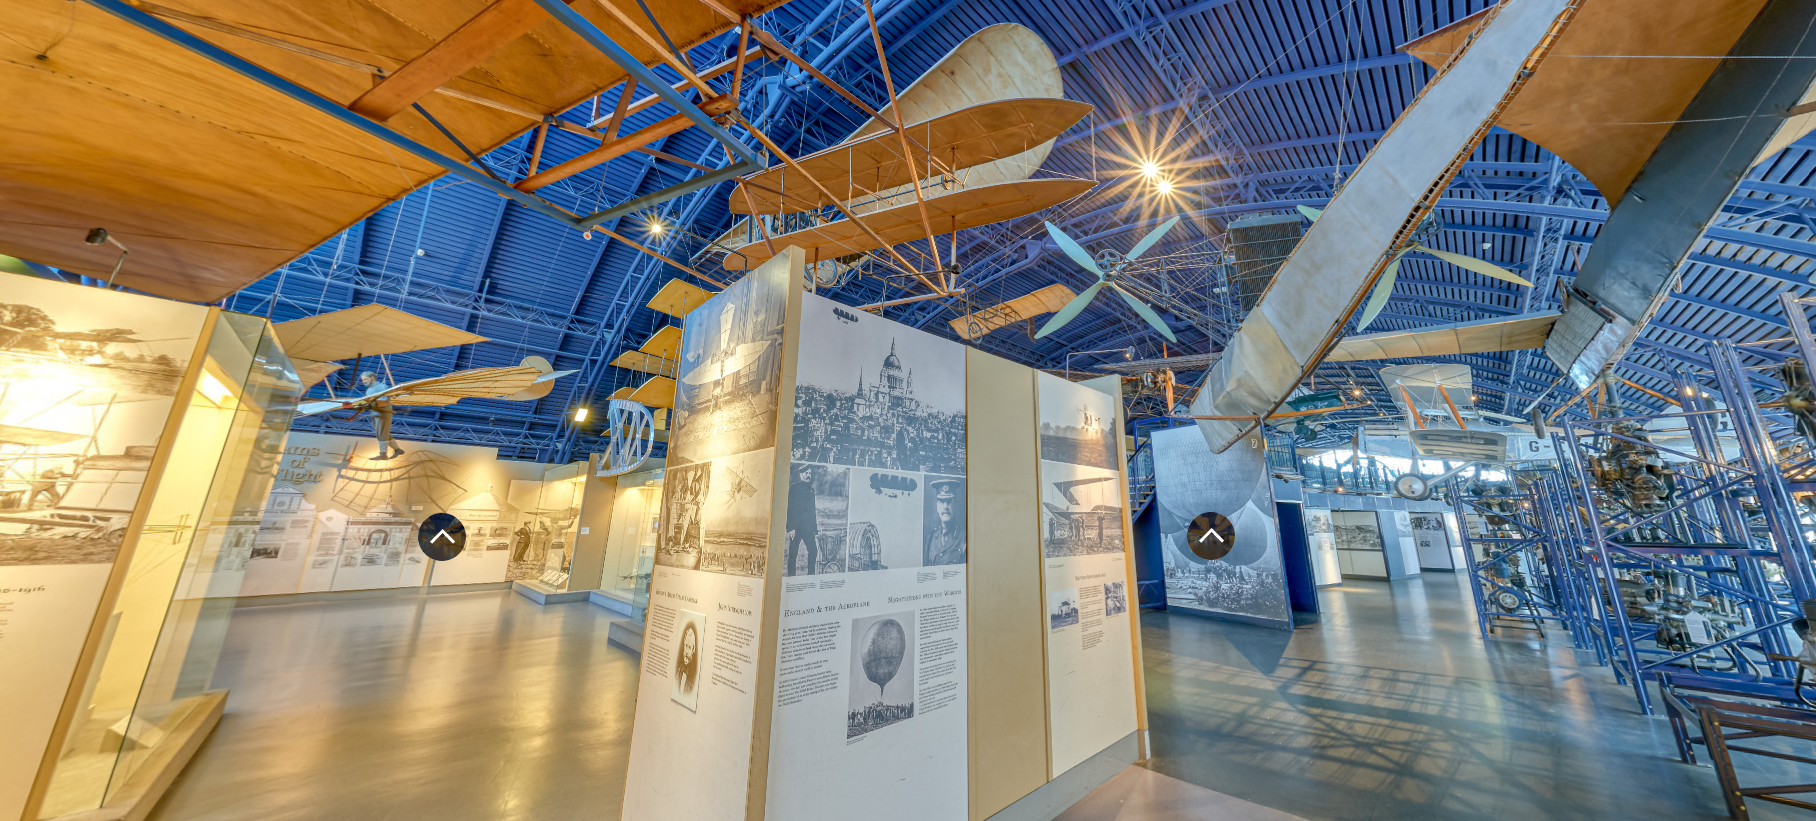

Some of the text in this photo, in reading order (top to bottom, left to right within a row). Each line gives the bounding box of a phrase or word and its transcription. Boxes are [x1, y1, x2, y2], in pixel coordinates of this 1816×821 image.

[284, 446, 320, 456] ams
[291, 456, 310, 468] of
[784, 607, 815, 617] ENGLAND
[817, 605, 823, 613] &
[838, 601, 870, 611] AEROPLANE
